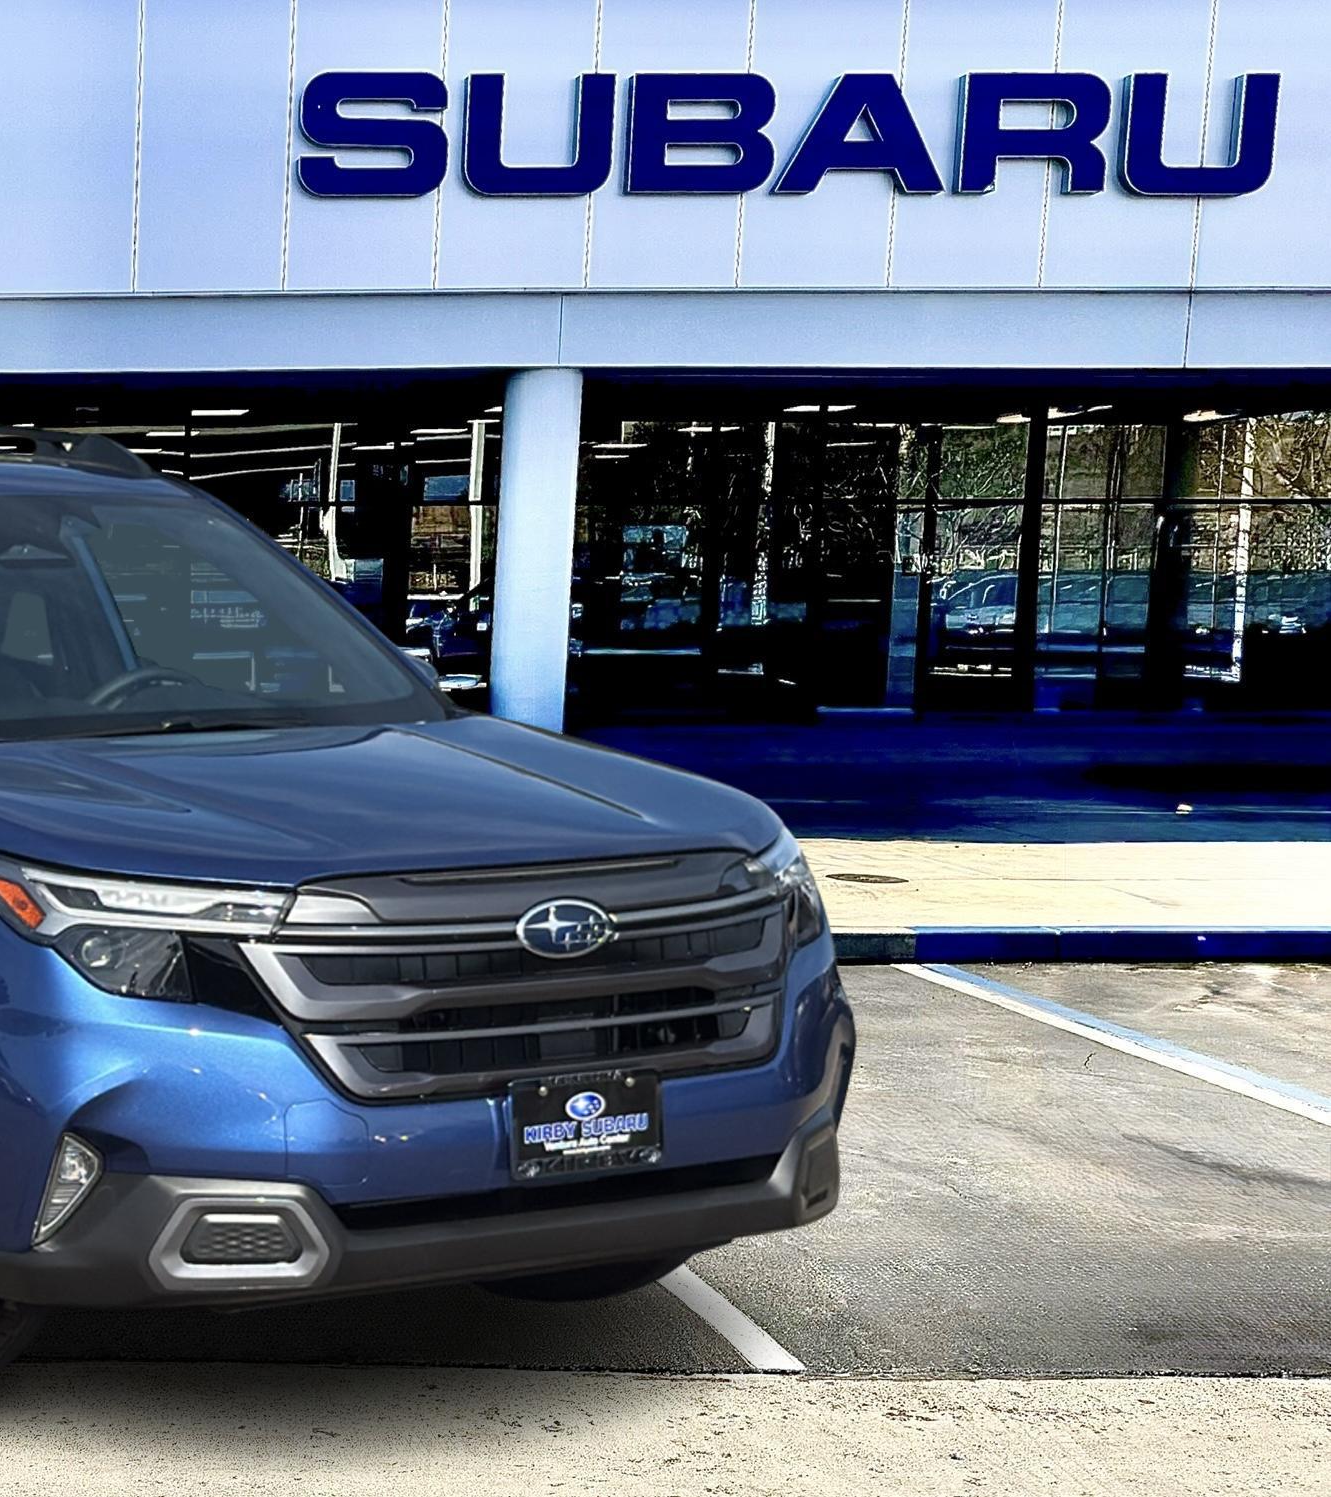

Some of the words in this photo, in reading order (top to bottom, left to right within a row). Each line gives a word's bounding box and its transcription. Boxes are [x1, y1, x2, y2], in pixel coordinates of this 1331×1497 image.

[297, 71, 1282, 198] SUBARU
[524, 1122, 577, 1144] KIRBY
[581, 1113, 649, 1136] SUBARU
[579, 1136, 599, 1147] Auto
[601, 1133, 630, 1145] Center
